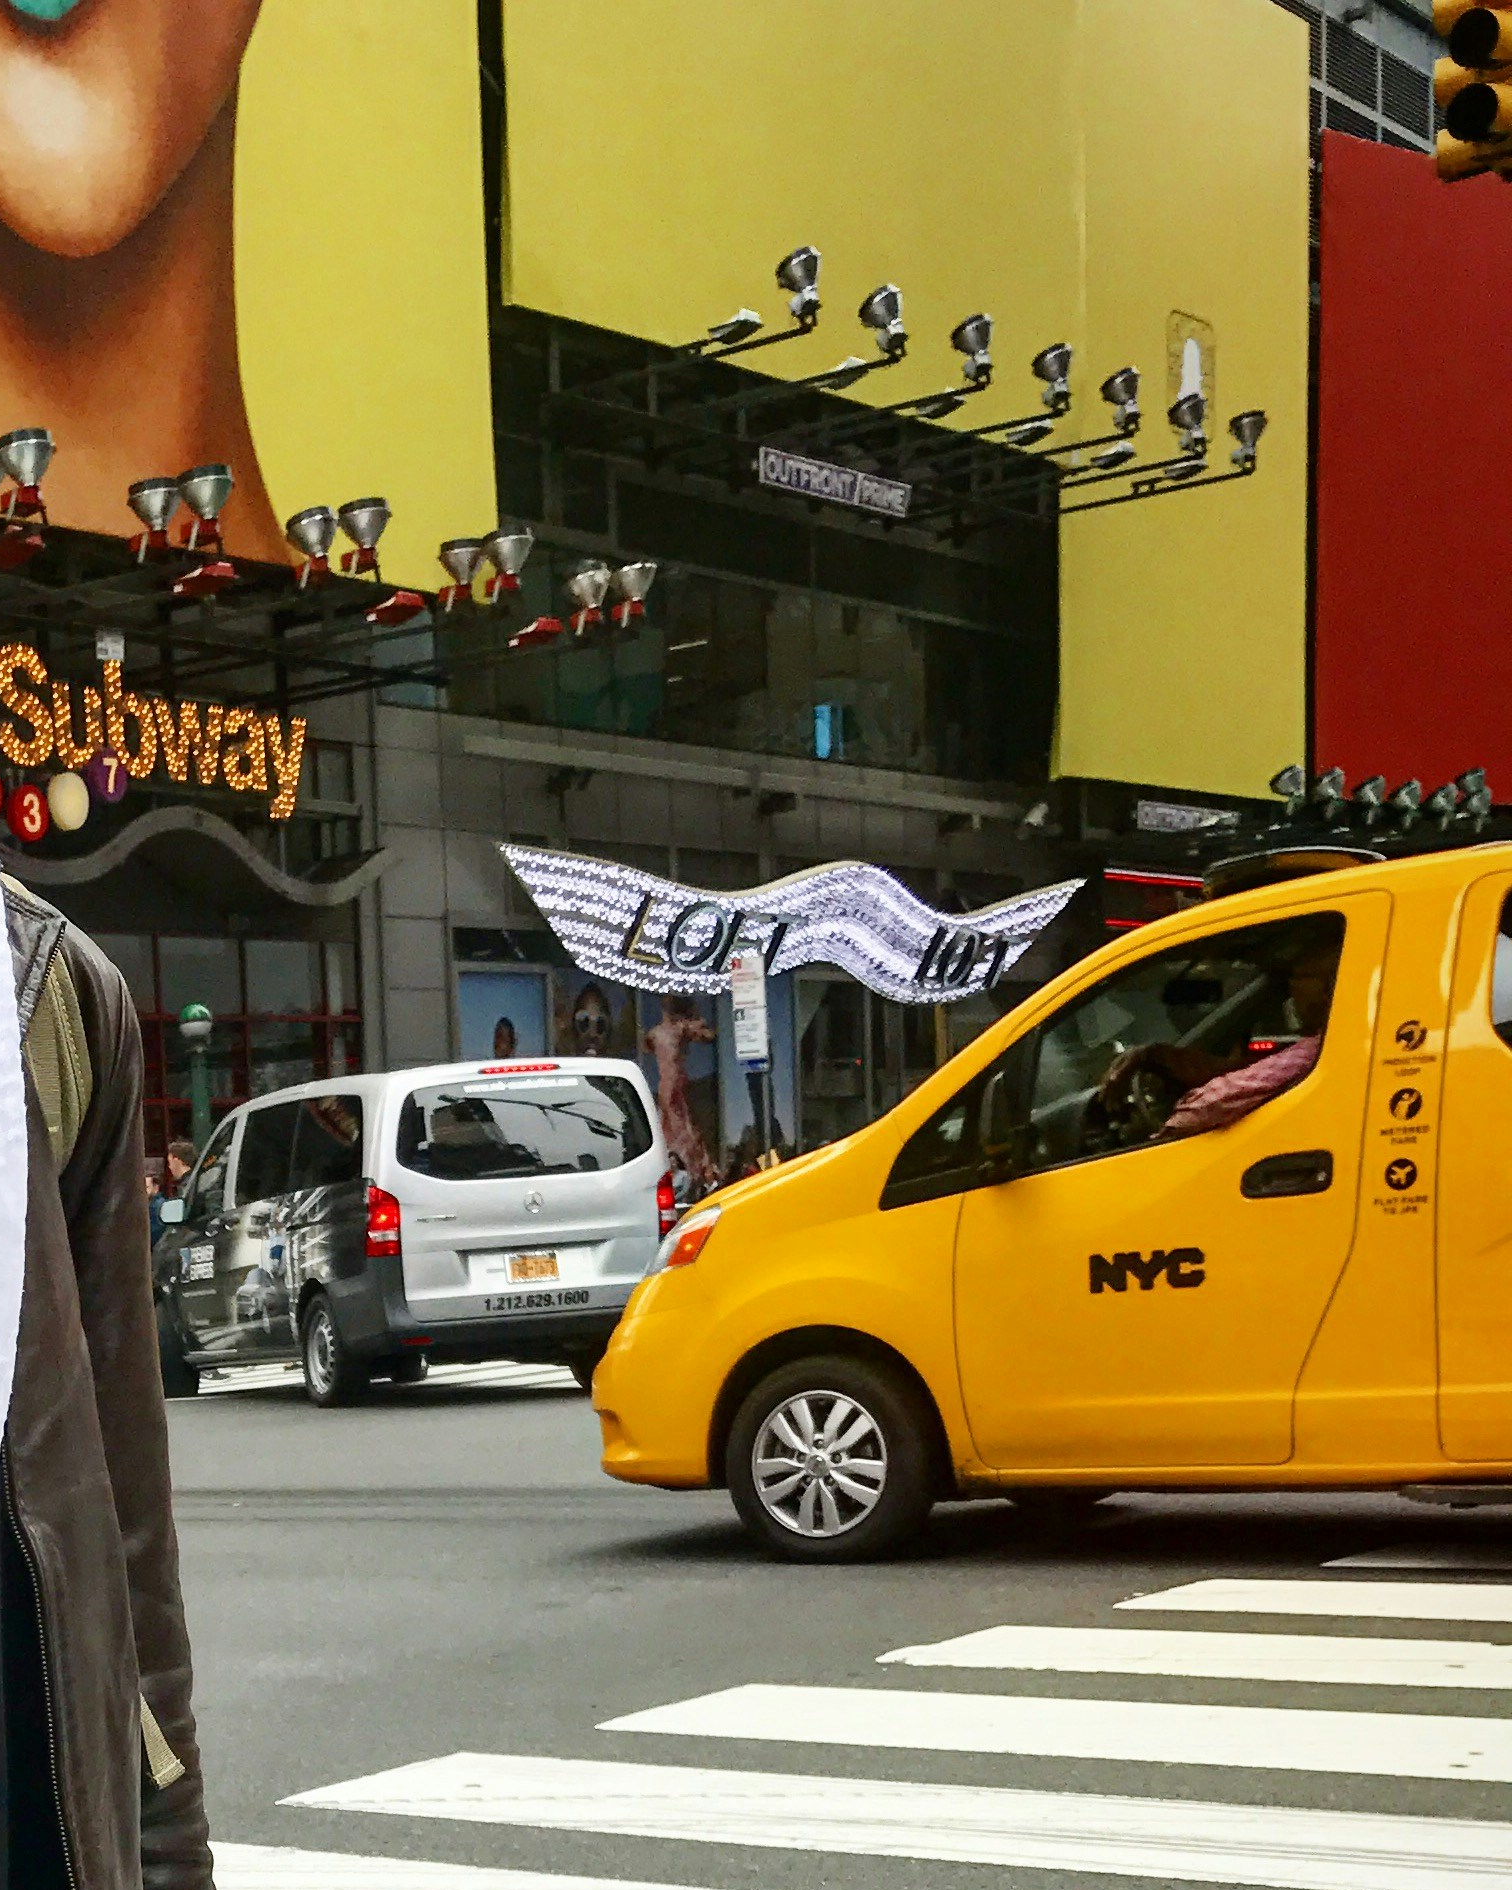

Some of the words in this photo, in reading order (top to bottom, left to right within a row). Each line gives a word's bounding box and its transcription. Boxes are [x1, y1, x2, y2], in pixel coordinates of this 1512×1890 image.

[22, 793, 42, 833] 3
[102, 757, 119, 794] 7
[622, 892, 809, 976] LOFT
[1089, 1247, 1206, 1294] NYC
